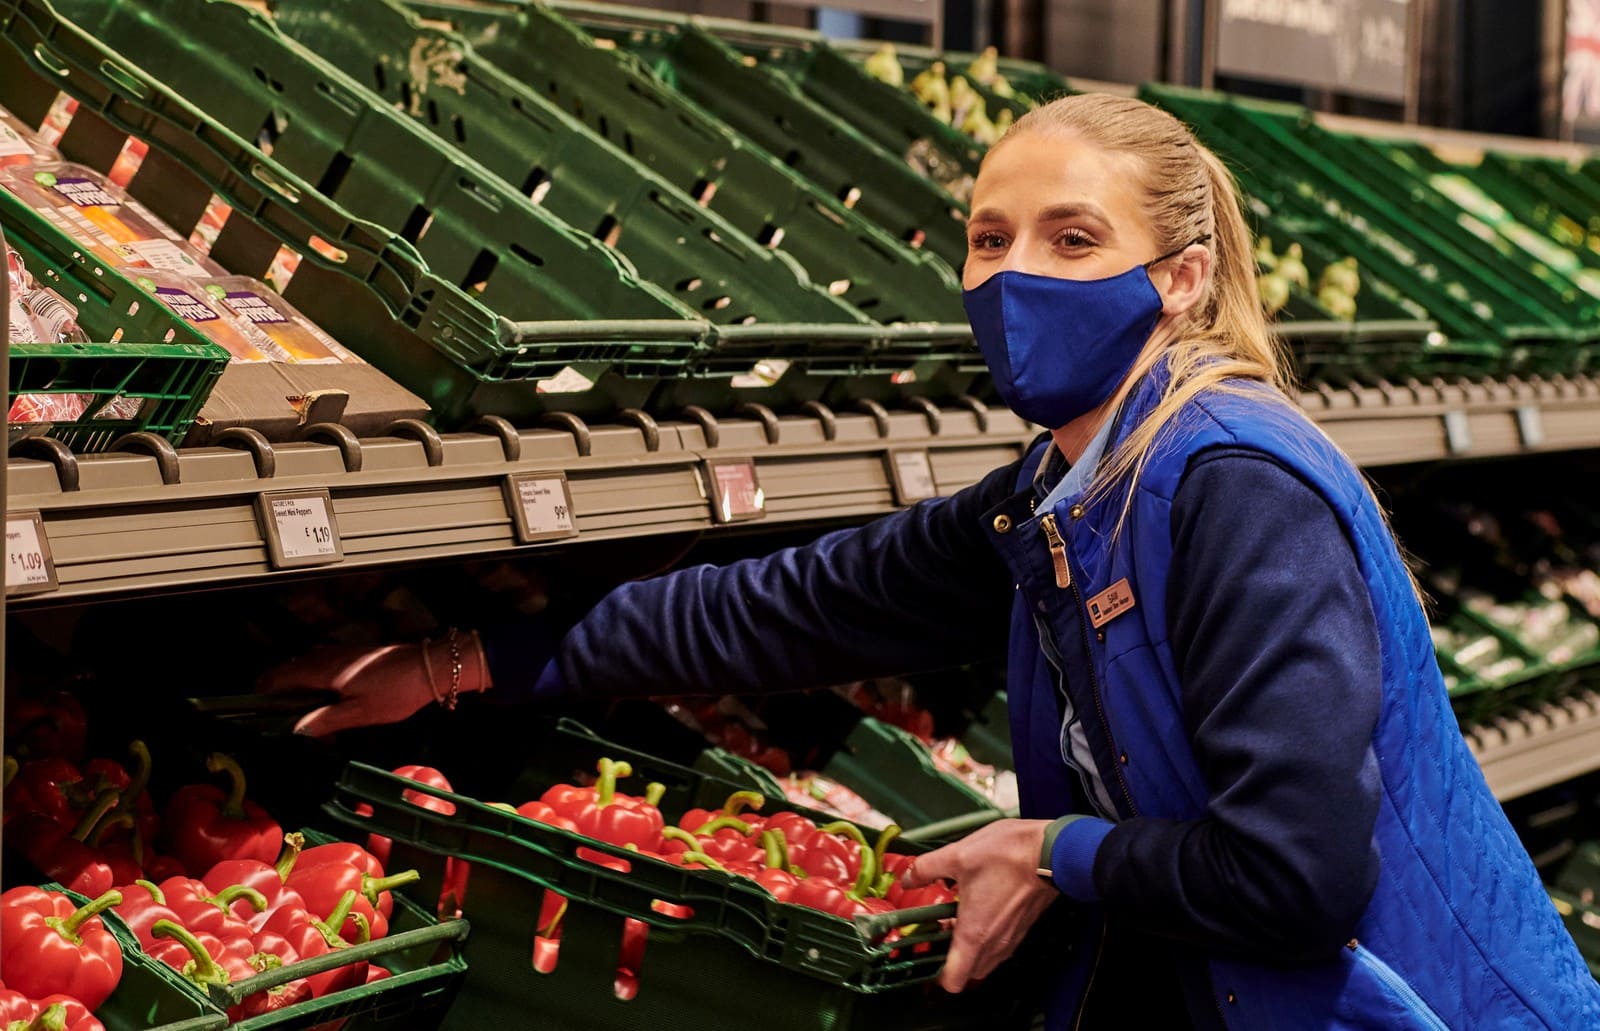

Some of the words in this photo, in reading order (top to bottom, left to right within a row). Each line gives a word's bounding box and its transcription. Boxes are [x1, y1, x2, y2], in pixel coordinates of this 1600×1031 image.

[296, 508, 312, 517] Peppers
[313, 526, 330, 543] 1.19
[18, 552, 42, 570] 1.09
